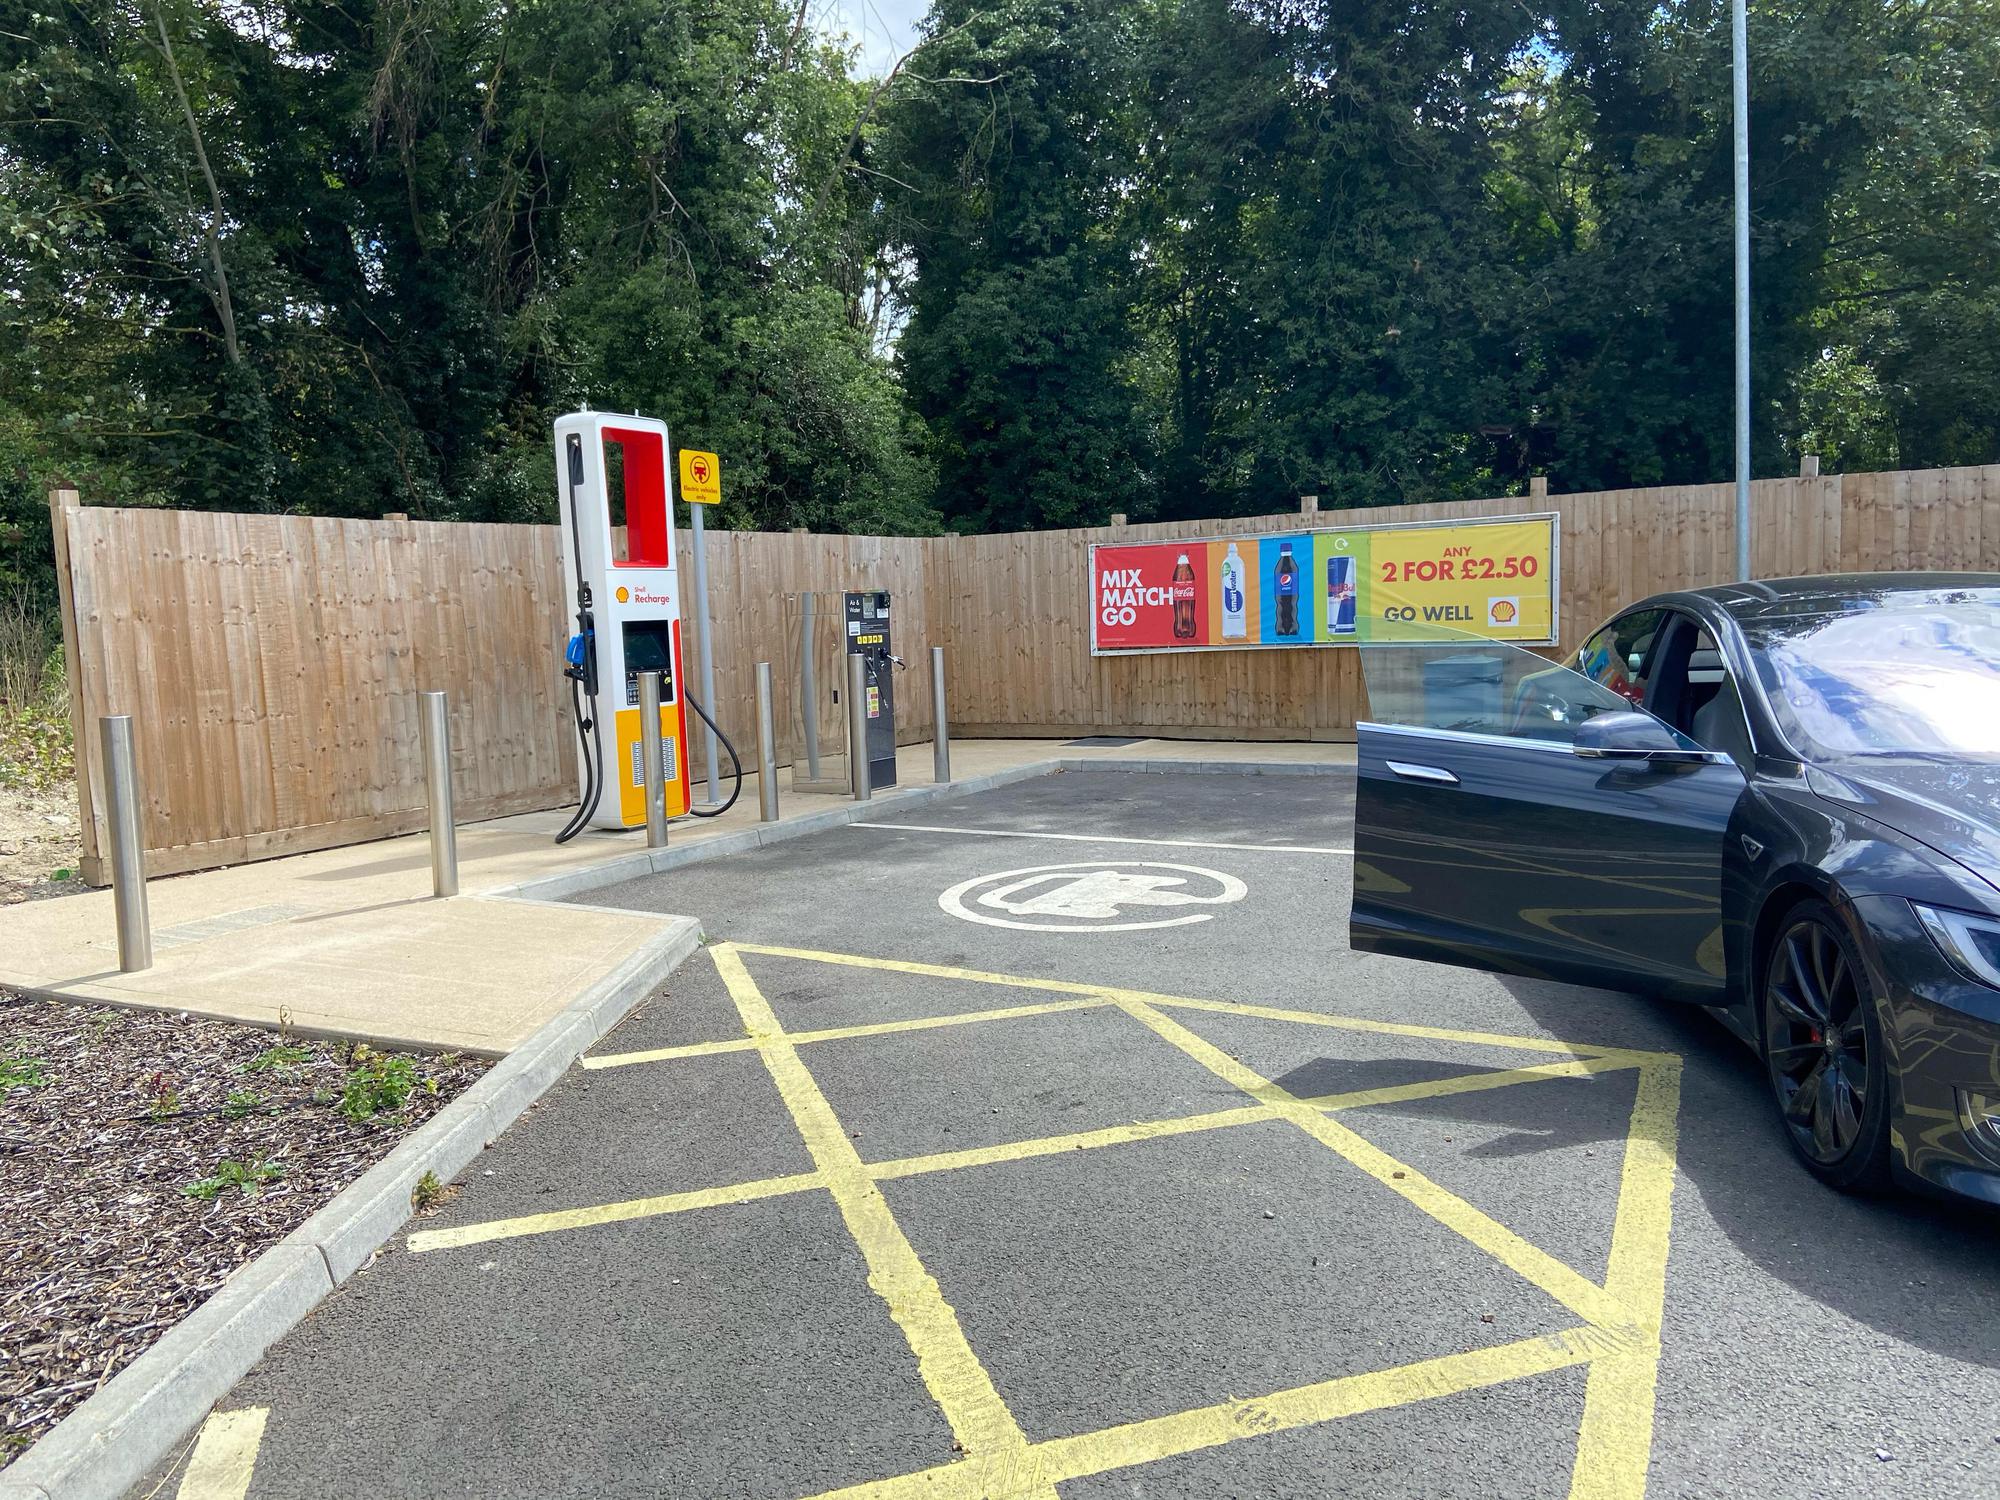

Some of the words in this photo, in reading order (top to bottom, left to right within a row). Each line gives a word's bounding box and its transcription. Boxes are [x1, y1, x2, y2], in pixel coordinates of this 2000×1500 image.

[1443, 546, 1472, 558] ANY
[1101, 568, 1143, 589] MIX
[1381, 562, 1397, 583] 2
[1403, 560, 1455, 582] FOR
[1460, 555, 1538, 580] £2.50
[634, 594, 670, 605] Recharge
[1101, 586, 1174, 607] MATCH
[1229, 570, 1238, 612] smartwater
[1101, 607, 1137, 626] GO
[1384, 606, 1417, 622] GO
[1422, 605, 1474, 621] WELL
